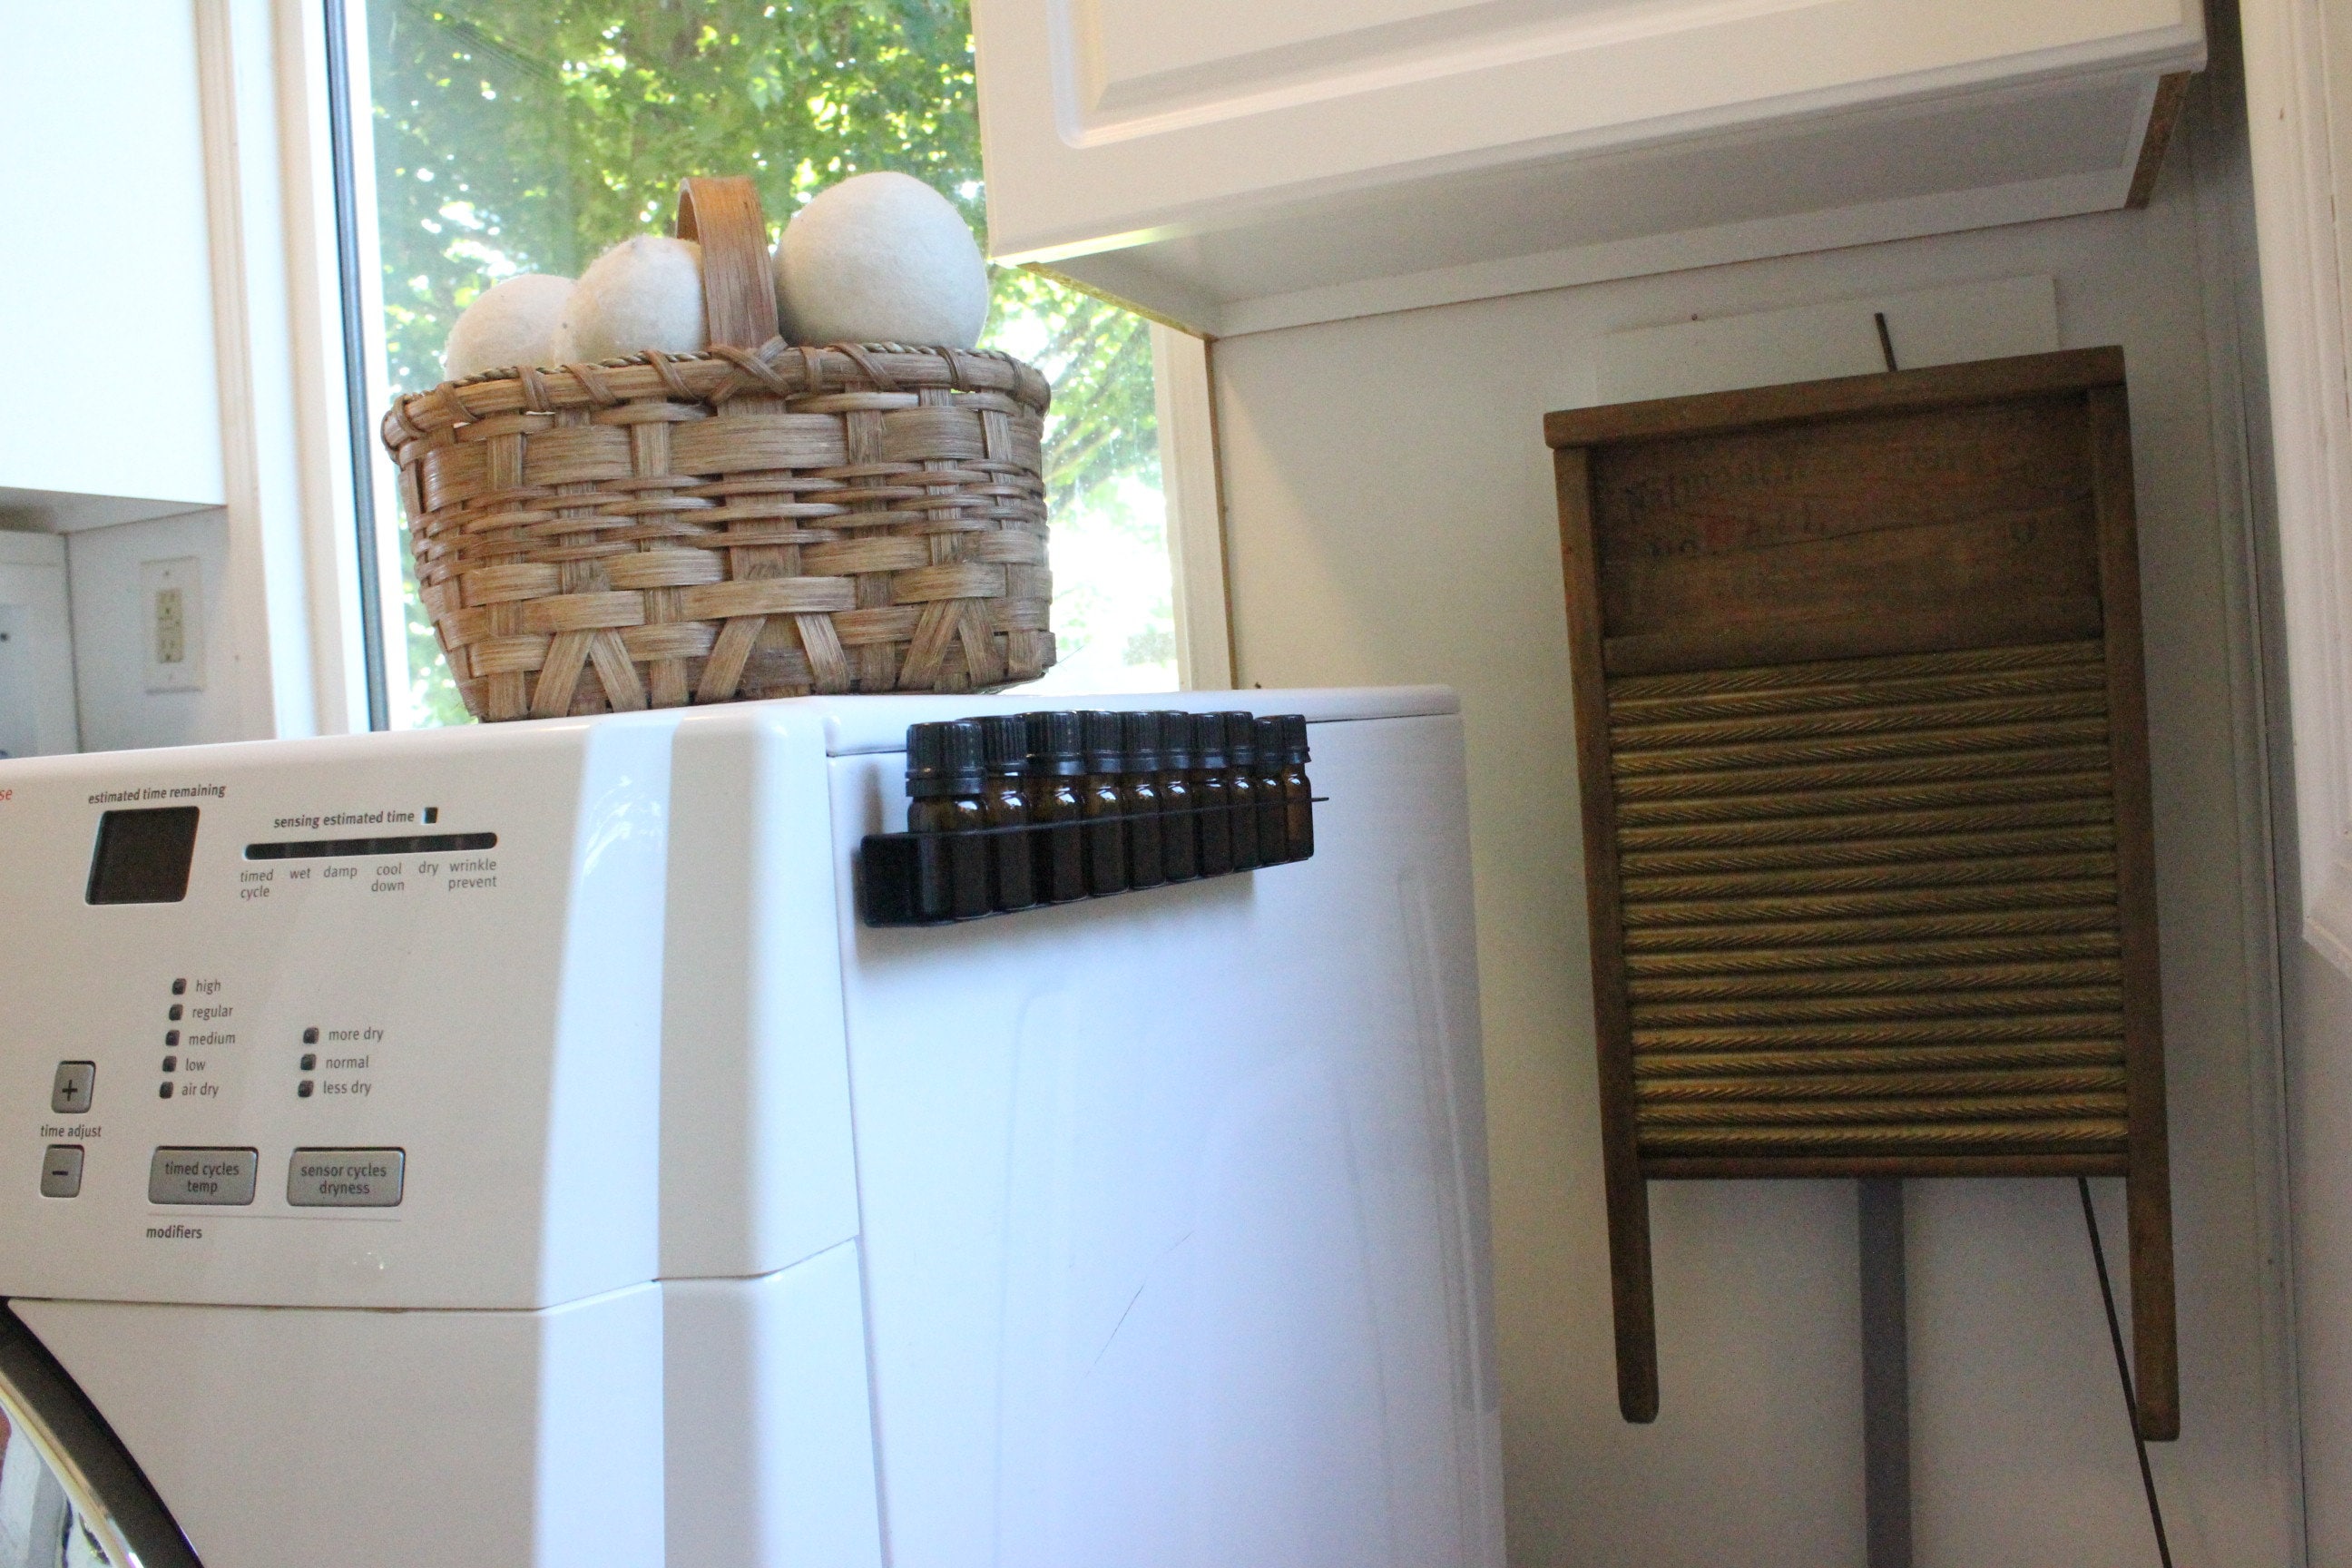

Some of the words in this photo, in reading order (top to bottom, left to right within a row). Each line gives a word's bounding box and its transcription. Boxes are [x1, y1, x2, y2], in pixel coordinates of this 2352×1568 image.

[88, 789, 141, 805] estimated
[142, 788, 167, 801] time
[169, 783, 226, 799] remaining
[273, 813, 320, 829] sensing
[323, 811, 384, 826] estimated
[387, 810, 415, 823] time
[289, 867, 311, 879] wet
[323, 865, 358, 881] damp
[376, 862, 402, 877] cool
[418, 861, 438, 877] dry
[449, 859, 497, 873] wrinkle
[240, 868, 273, 883] timed
[448, 875, 497, 891] prevent
[240, 885, 270, 901] cycle
[371, 878, 405, 892] down
[196, 979, 221, 994] high
[192, 1004, 233, 1019] regular
[188, 1032, 236, 1045] medium
[328, 1028, 360, 1040] more
[364, 1026, 384, 1042] dry
[186, 1058, 206, 1071] low
[326, 1055, 369, 1069] normal
[181, 1083, 198, 1096] air
[200, 1083, 219, 1099] dry
[323, 1082, 348, 1093] less
[350, 1081, 371, 1096] dry
[41, 1123, 64, 1138] time
[67, 1124, 102, 1139] adjust
[165, 1161, 200, 1176] timed
[202, 1162, 240, 1178] cycles
[300, 1163, 344, 1177] sensor
[346, 1163, 387, 1179] cycles
[187, 1181, 218, 1196] temp
[319, 1181, 370, 1197] dryness
[146, 1224, 202, 1240] modifiers
